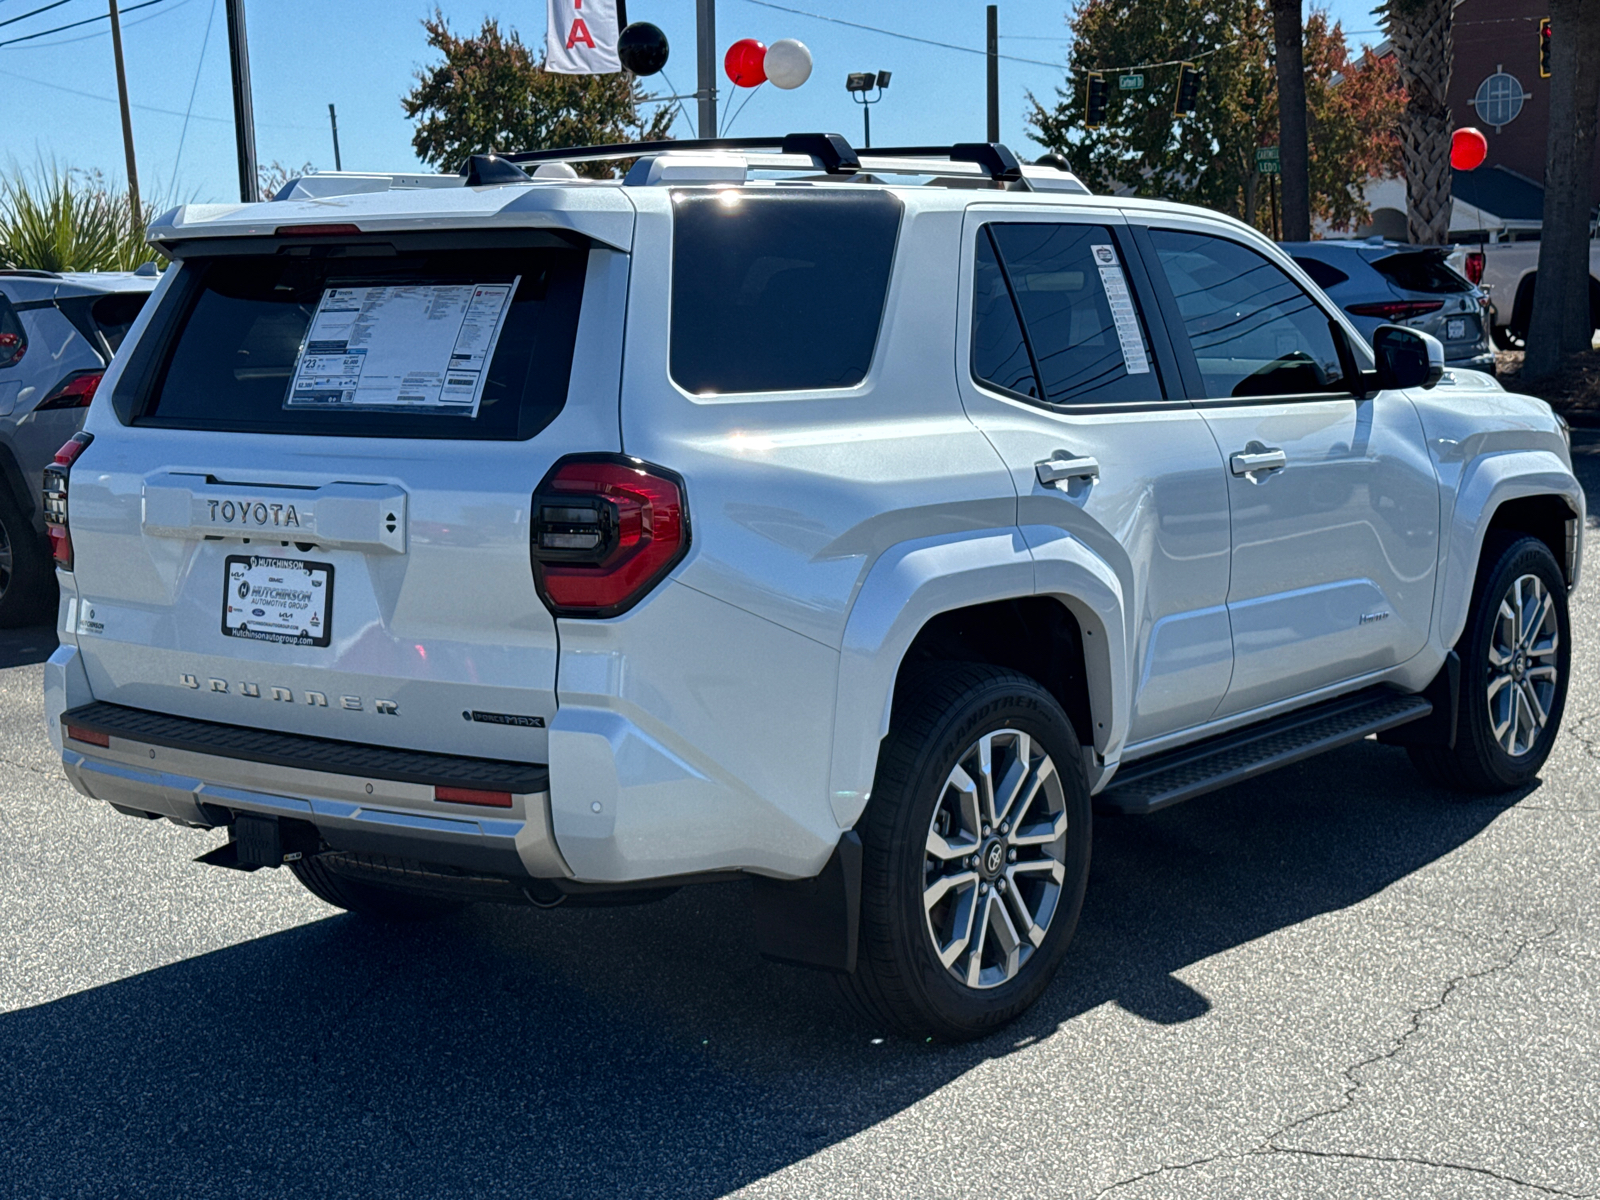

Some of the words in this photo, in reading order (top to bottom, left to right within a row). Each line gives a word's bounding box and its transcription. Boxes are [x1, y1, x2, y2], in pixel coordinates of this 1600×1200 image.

[1259, 161, 1278, 172] LEDO
[207, 499, 300, 528] TOYOTA
[258, 558, 304, 570] HUTCHINSON
[251, 585, 313, 603] HUTCHINSON
[250, 598, 287, 609] AUTOMOTIVE
[288, 602, 309, 611] GROUP
[231, 628, 314, 645] Hutchinsonautogroup.com
[179, 673, 401, 717] 4RUNNER
